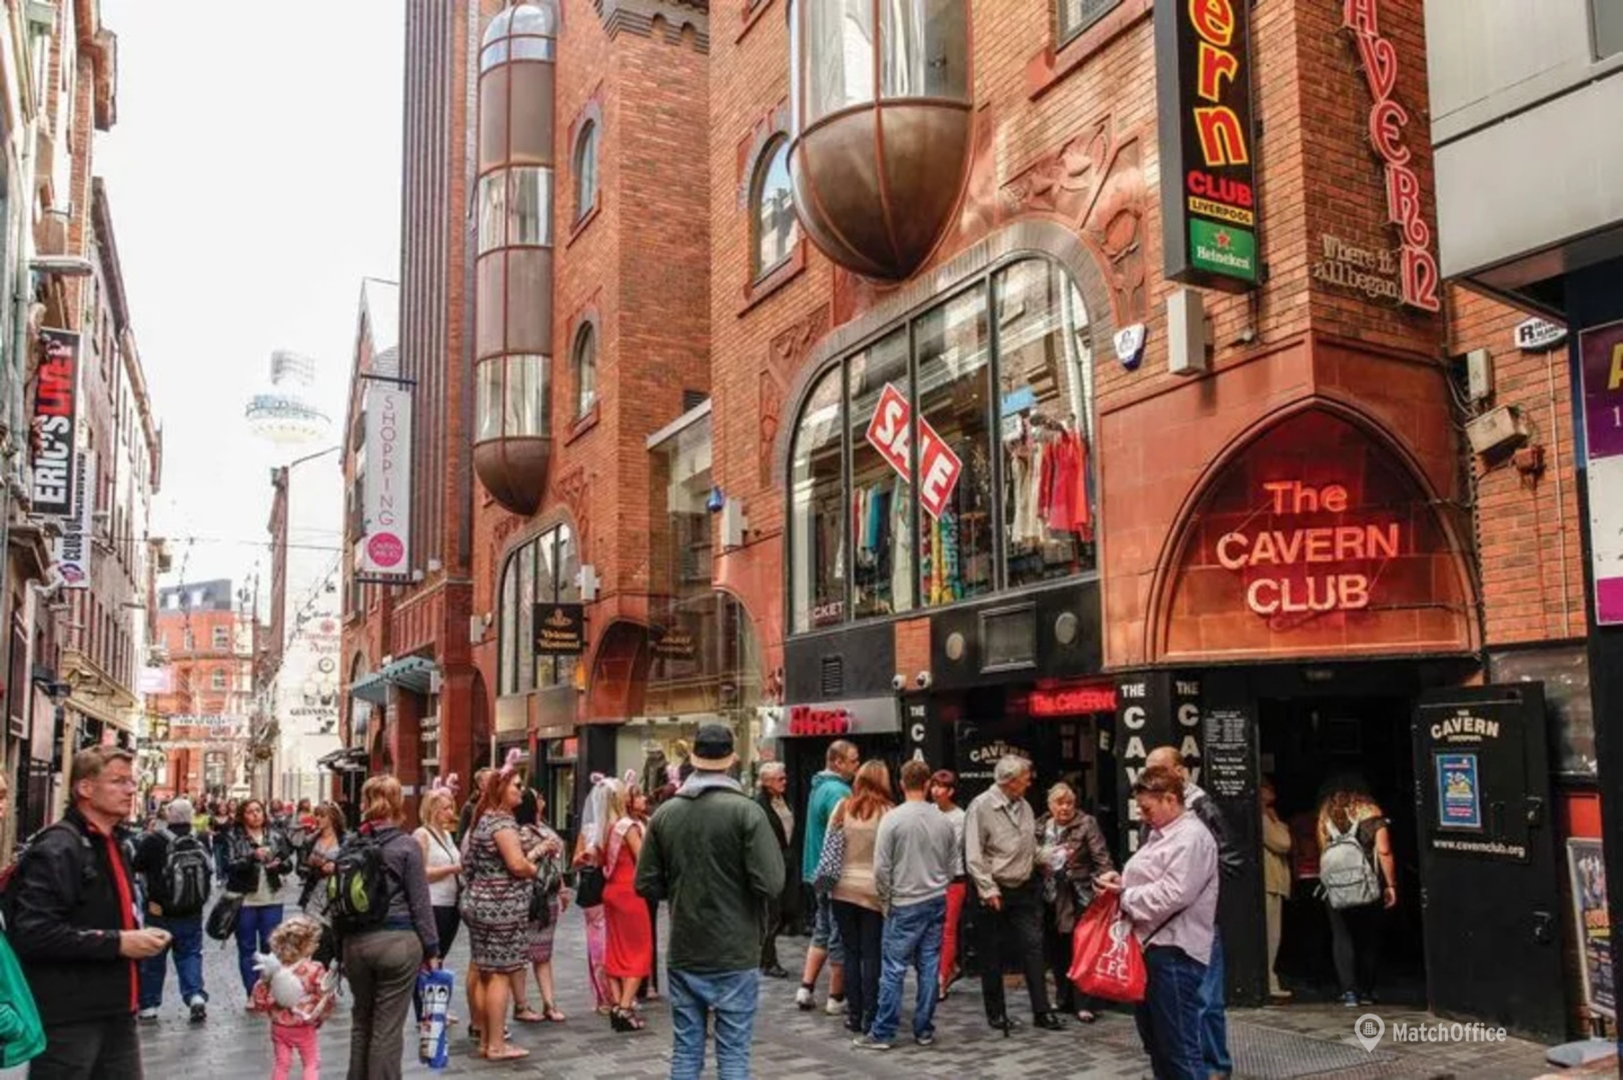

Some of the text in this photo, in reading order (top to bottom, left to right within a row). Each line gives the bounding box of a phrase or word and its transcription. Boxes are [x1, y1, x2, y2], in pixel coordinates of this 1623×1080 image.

[1188, 170, 1252, 206] CLUB
[1192, 198, 1251, 223] LIVERPOOL
[1196, 245, 1251, 270] Heineken
[1322, 233, 1377, 268] Where
[1346, 264, 1398, 298] began
[379, 395, 397, 526] SHOPPING
[1263, 480, 1348, 516] The
[1216, 523, 1399, 570] CAVERN
[1247, 574, 1370, 614] CLUB
[1121, 684, 1146, 697] THE
[1176, 681, 1199, 695] THE
[910, 705, 925, 717] THE
[1431, 717, 1500, 739] CAVERN
[1432, 839, 1525, 858] www.cavernclub.org
